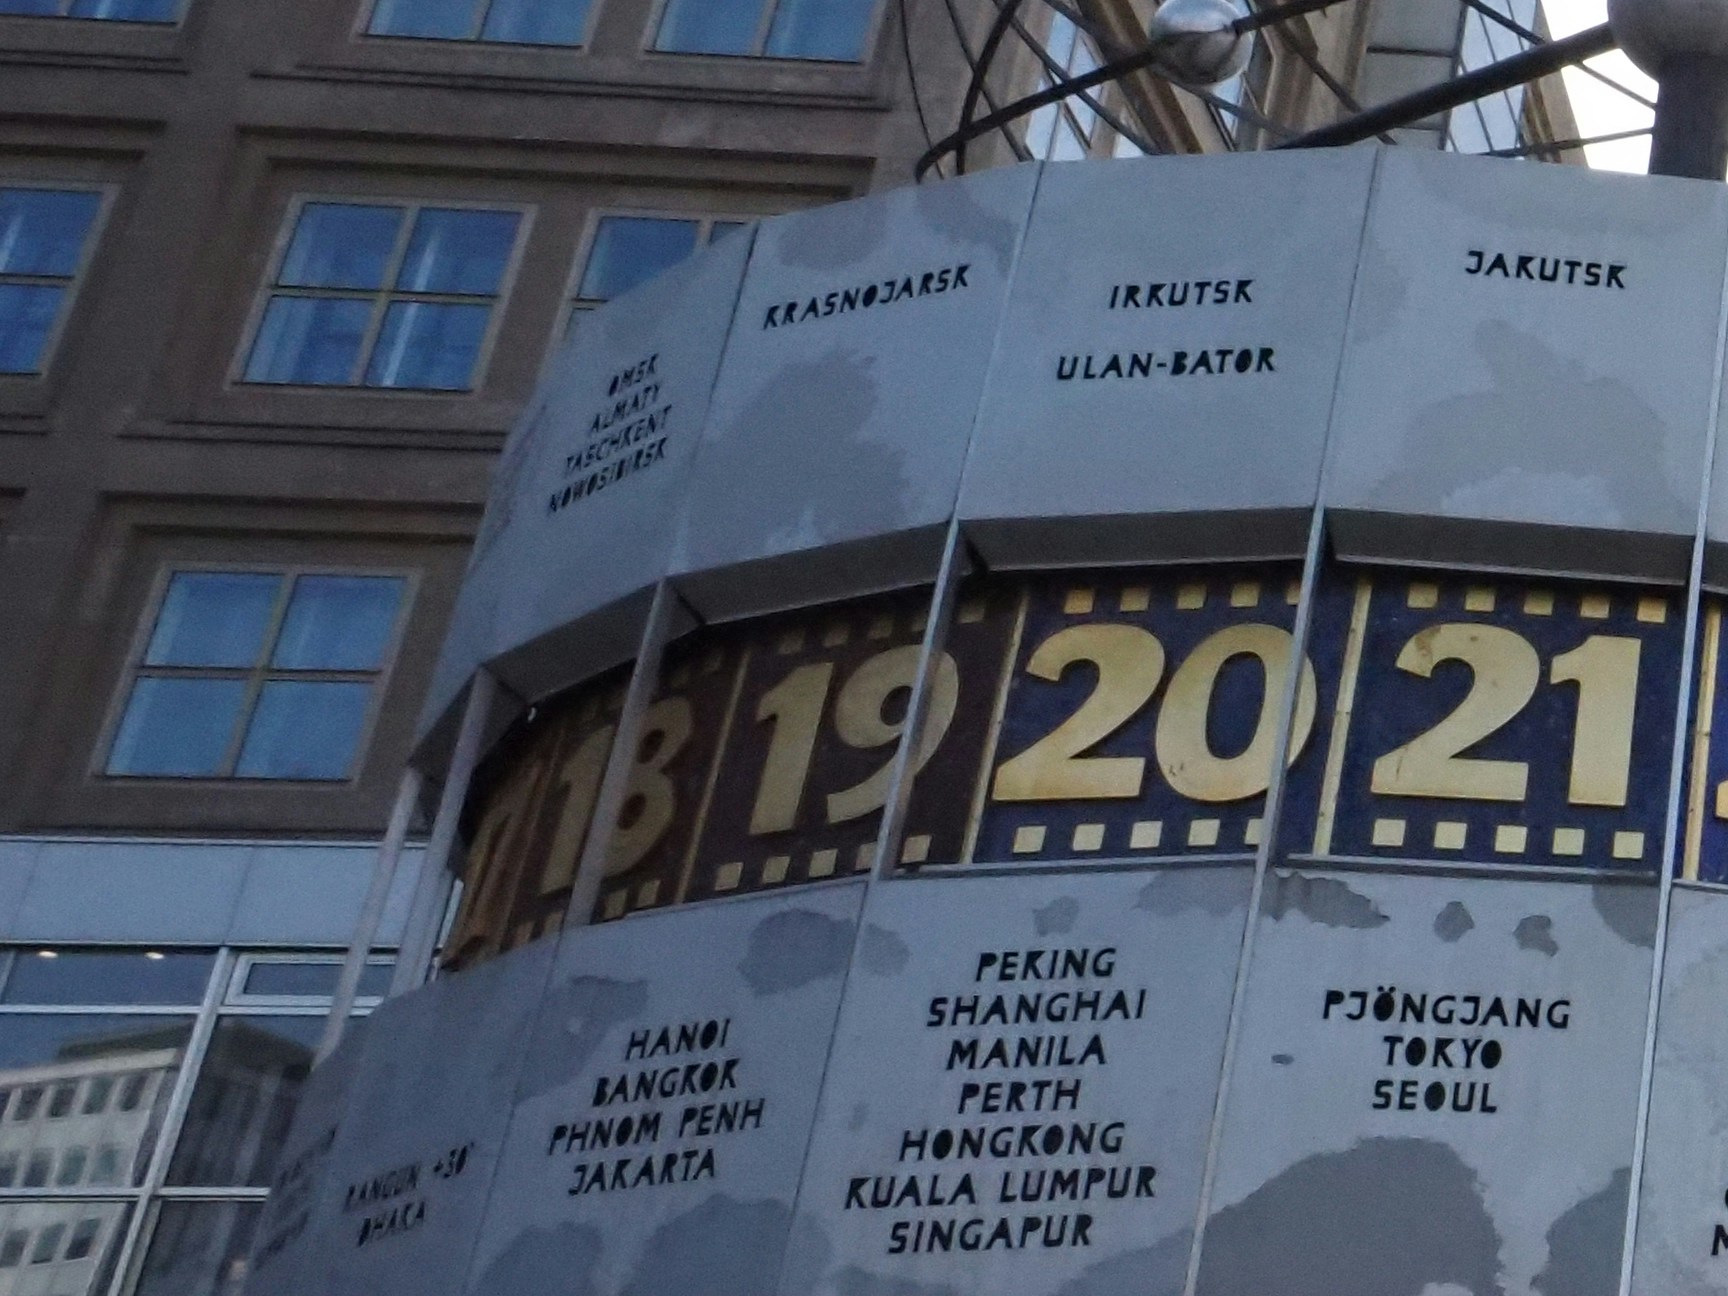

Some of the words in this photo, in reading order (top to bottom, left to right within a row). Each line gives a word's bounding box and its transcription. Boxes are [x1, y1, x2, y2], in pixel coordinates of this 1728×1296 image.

[1466, 250, 1627, 289] JAKUTSK
[762, 262, 973, 331] KRASNOJARSK
[1108, 278, 1256, 308] IRKUTSK
[1056, 346, 1276, 382] ULAN-BATOR
[991, 623, 1317, 802] 20
[1371, 622, 1642, 807] 21
[749, 645, 962, 836] 19
[975, 947, 1116, 982] PEKING
[927, 989, 1147, 1027] SHANGHAI
[1322, 985, 1571, 1029] PJÖNGJANG
[625, 1018, 731, 1062] HANOI
[946, 1035, 1107, 1070] MANILA
[1383, 1035, 1502, 1070] TOKYO
[592, 1058, 740, 1107] BANGKOK
[957, 1079, 1081, 1114] PERTH
[1372, 1079, 1498, 1114] SEOUL
[548, 1112, 659, 1156] PHNOM
[678, 1098, 765, 1138] PENH
[899, 1122, 1125, 1162] HONGKONG
[567, 1148, 716, 1196] JAKARTA
[844, 1173, 977, 1210] KUALA
[1000, 1165, 1158, 1202] LUMPUR
[887, 1214, 1093, 1254] SINGAPUR
